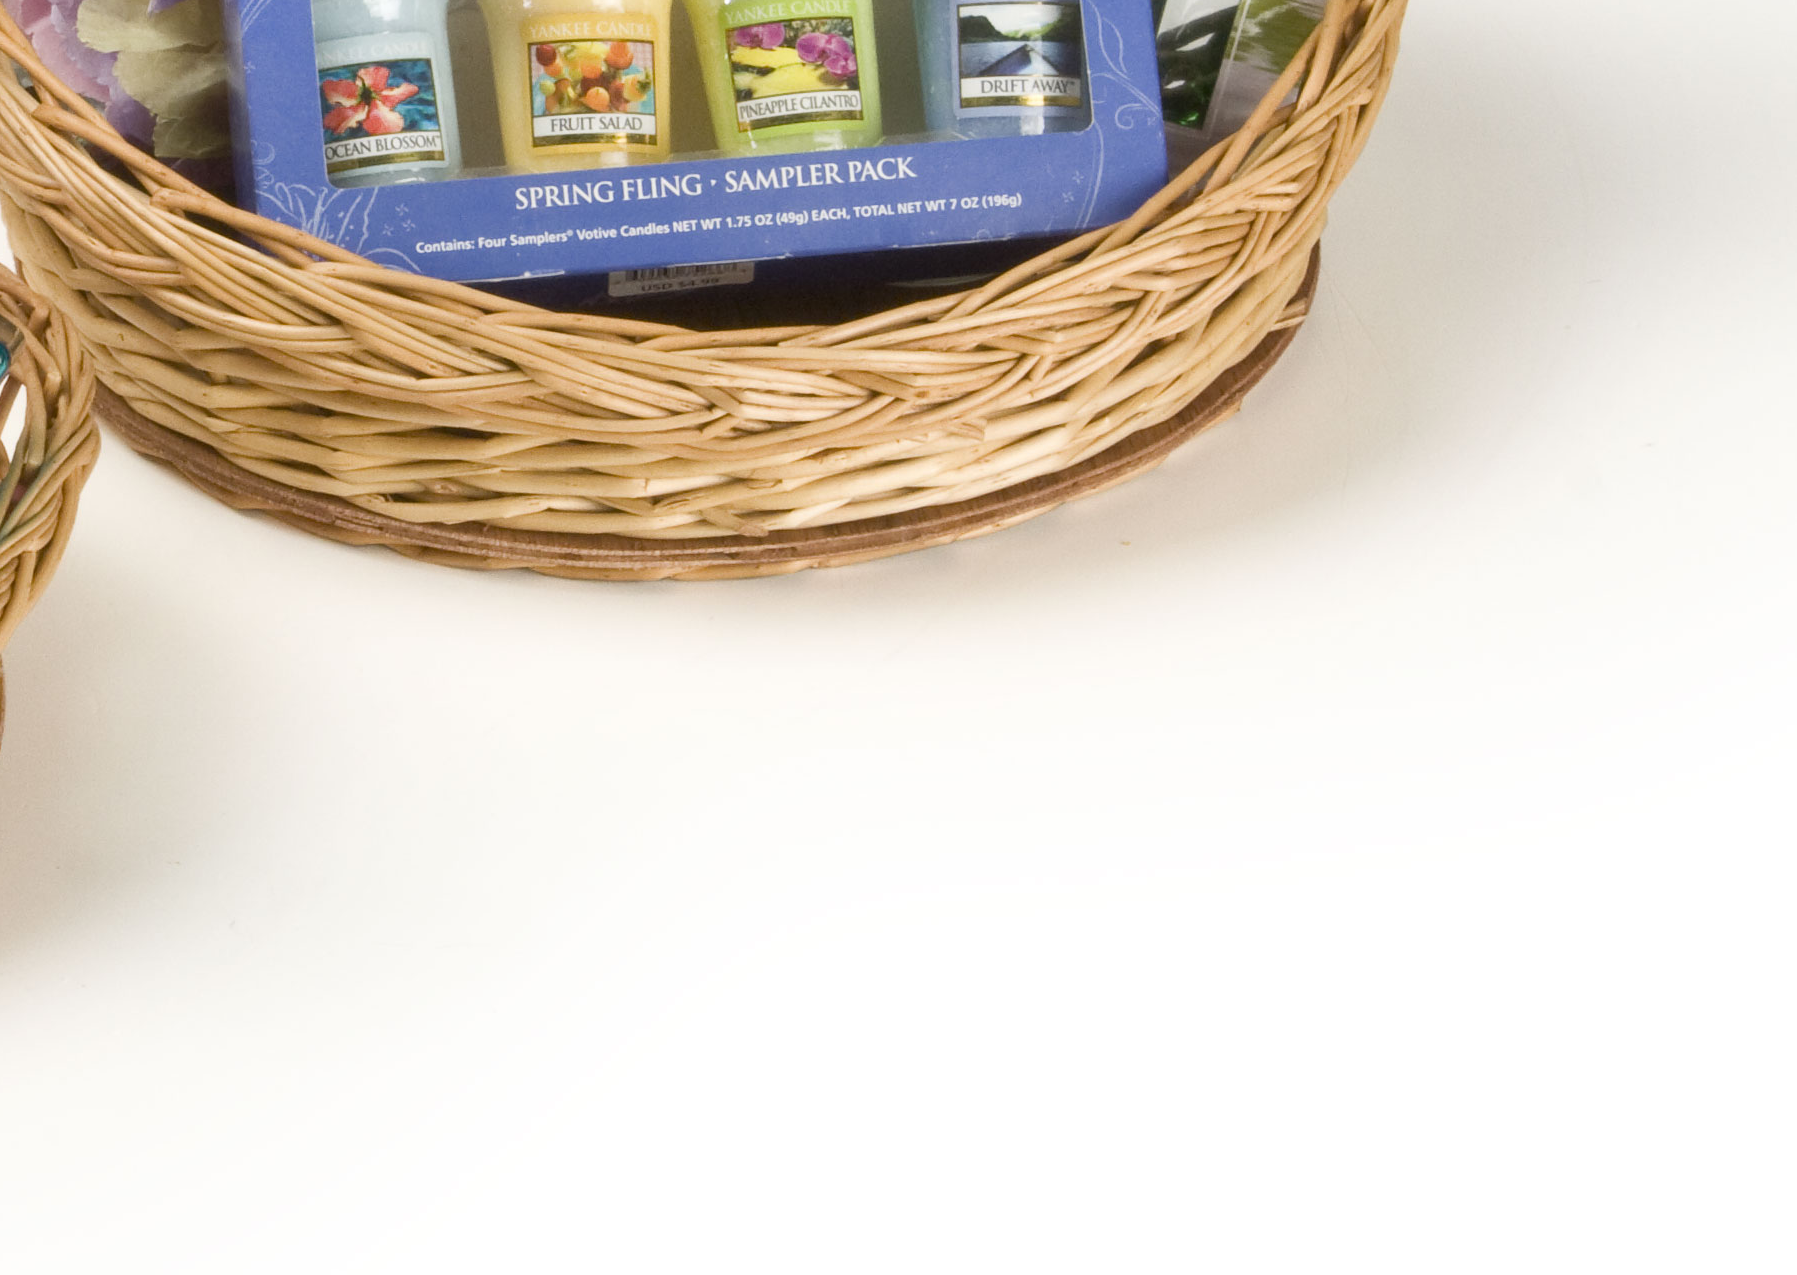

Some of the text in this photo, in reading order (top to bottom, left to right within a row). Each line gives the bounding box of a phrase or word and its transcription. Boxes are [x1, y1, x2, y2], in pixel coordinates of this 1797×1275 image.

[724, 2, 788, 25] YANKEE
[980, 78, 1029, 94] DRIFT
[738, 93, 860, 120] PINEAPPLE CILANTRO
[549, 115, 643, 133] FRUIT SALAD
[324, 140, 373, 161] OCEAN
[515, 156, 919, 211] SPRING FLING SAMPLER PACK
[415, 239, 476, 255] Contains:
[478, 236, 507, 249] Four
[576, 227, 618, 241] Votive
[619, 222, 671, 238] Candles
[672, 219, 698, 233] NET
[700, 217, 723, 231] WT
[725, 215, 752, 229] 1.75
[754, 213, 774, 227] OZ
[775, 210, 809, 226] (49g)
[811, 207, 851, 223] EACH,
[852, 204, 895, 219] TOTAL
[897, 201, 923, 215] NET
[924, 199, 947, 212] WT
[949, 197, 958, 211] 7
[960, 196, 980, 210] OZ
[981, 192, 1023, 209] (196g)
